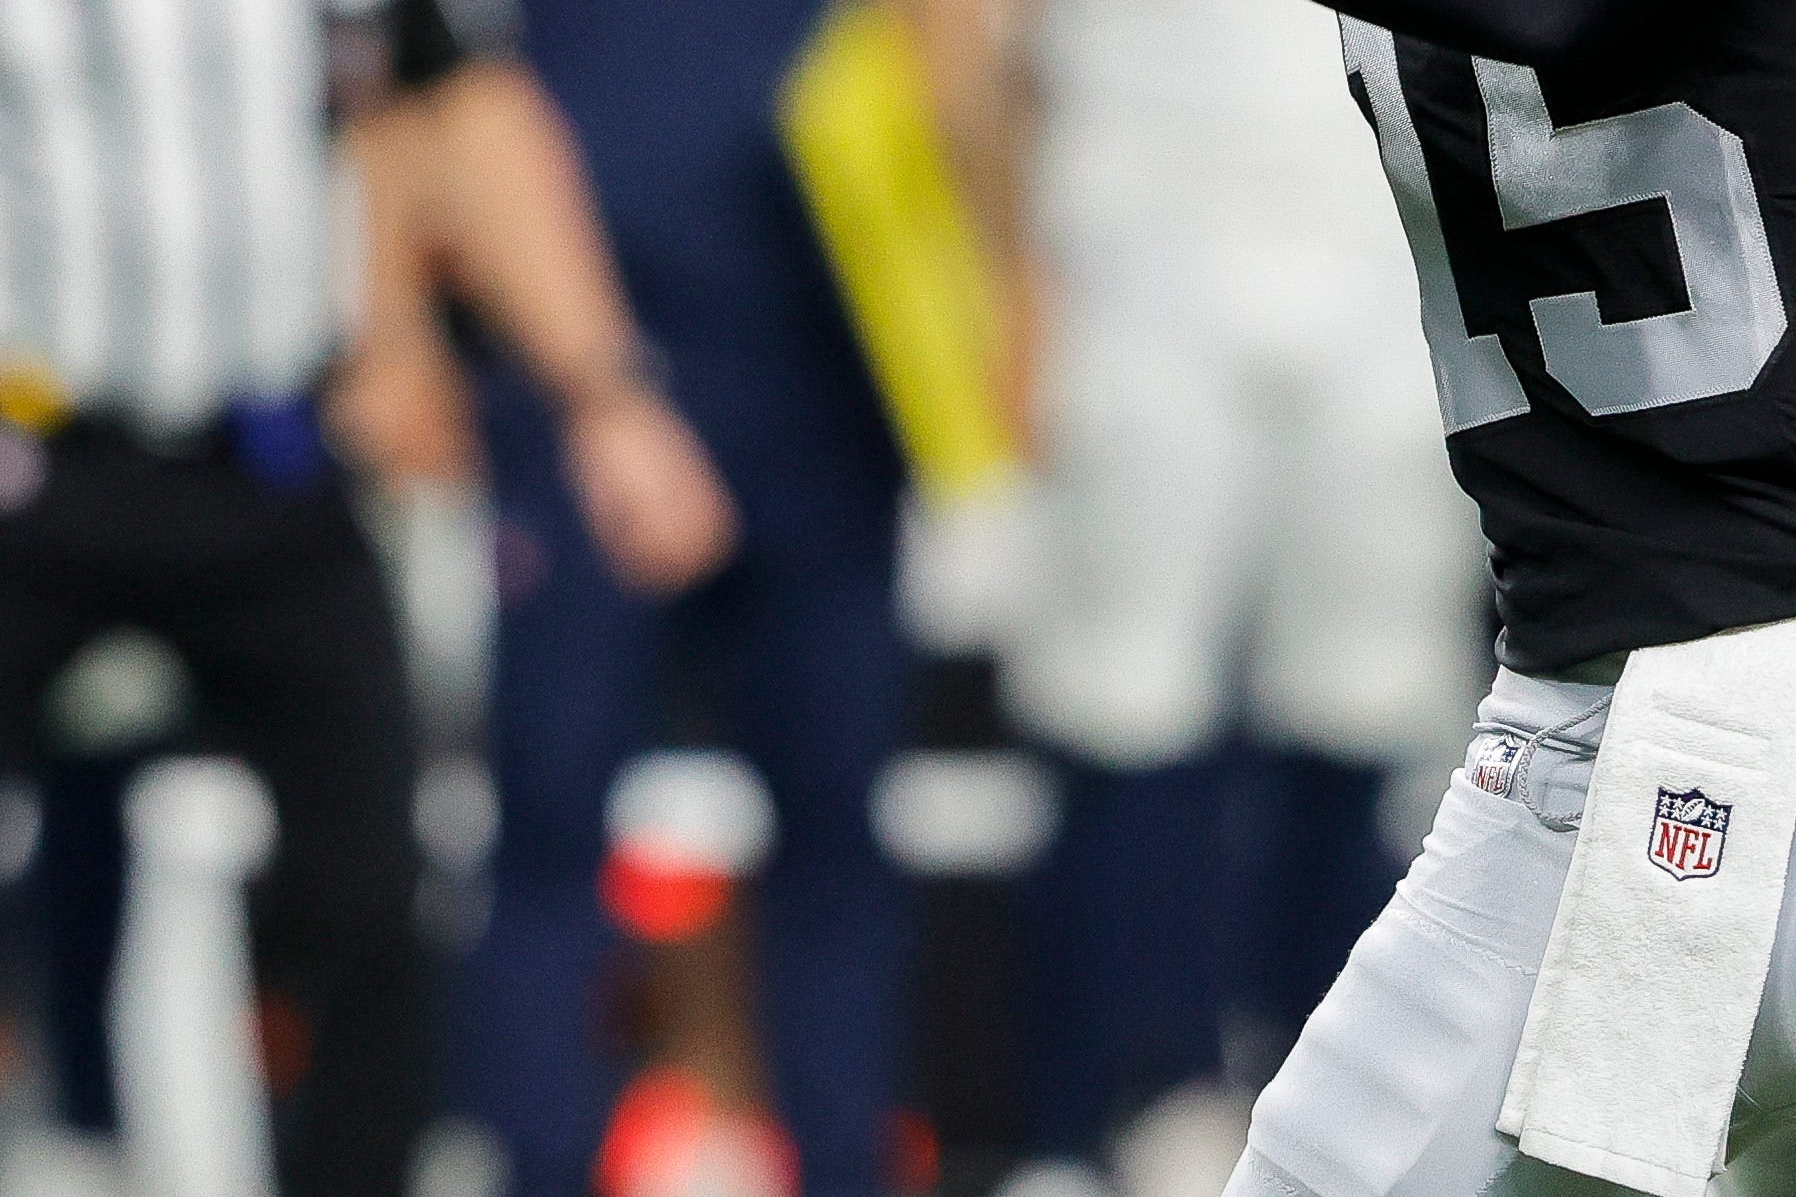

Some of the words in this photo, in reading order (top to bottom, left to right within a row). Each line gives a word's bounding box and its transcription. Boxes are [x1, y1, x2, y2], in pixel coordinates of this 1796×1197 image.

[1336, 11, 1788, 438] 15
[1475, 765, 1504, 792] NFL
[1654, 821, 1713, 871] NFL
